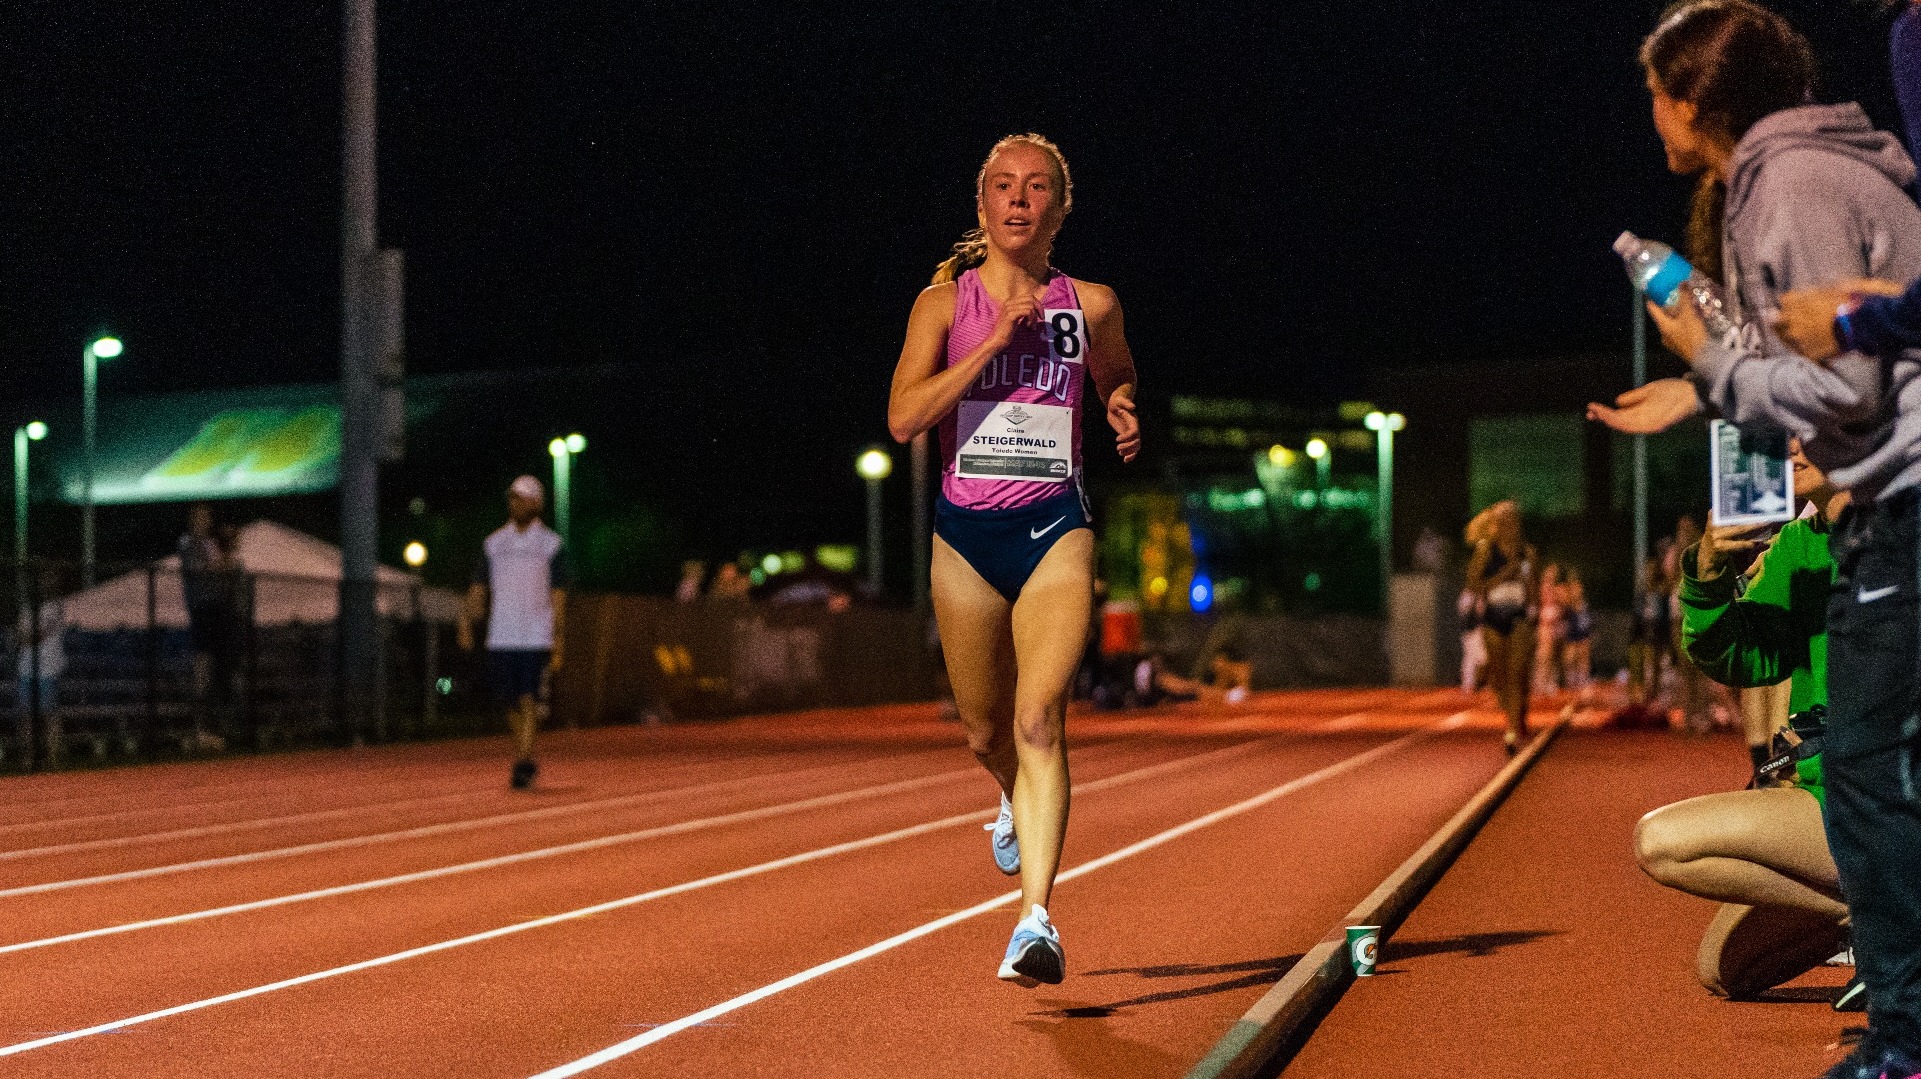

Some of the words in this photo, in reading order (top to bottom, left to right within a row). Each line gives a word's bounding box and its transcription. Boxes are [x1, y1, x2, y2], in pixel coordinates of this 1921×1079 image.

[1051, 312, 1080, 359] 8
[966, 354, 1071, 402] OLEDO
[972, 435, 1057, 448] STEIGERWALD
[1760, 755, 1790, 773] Canon
